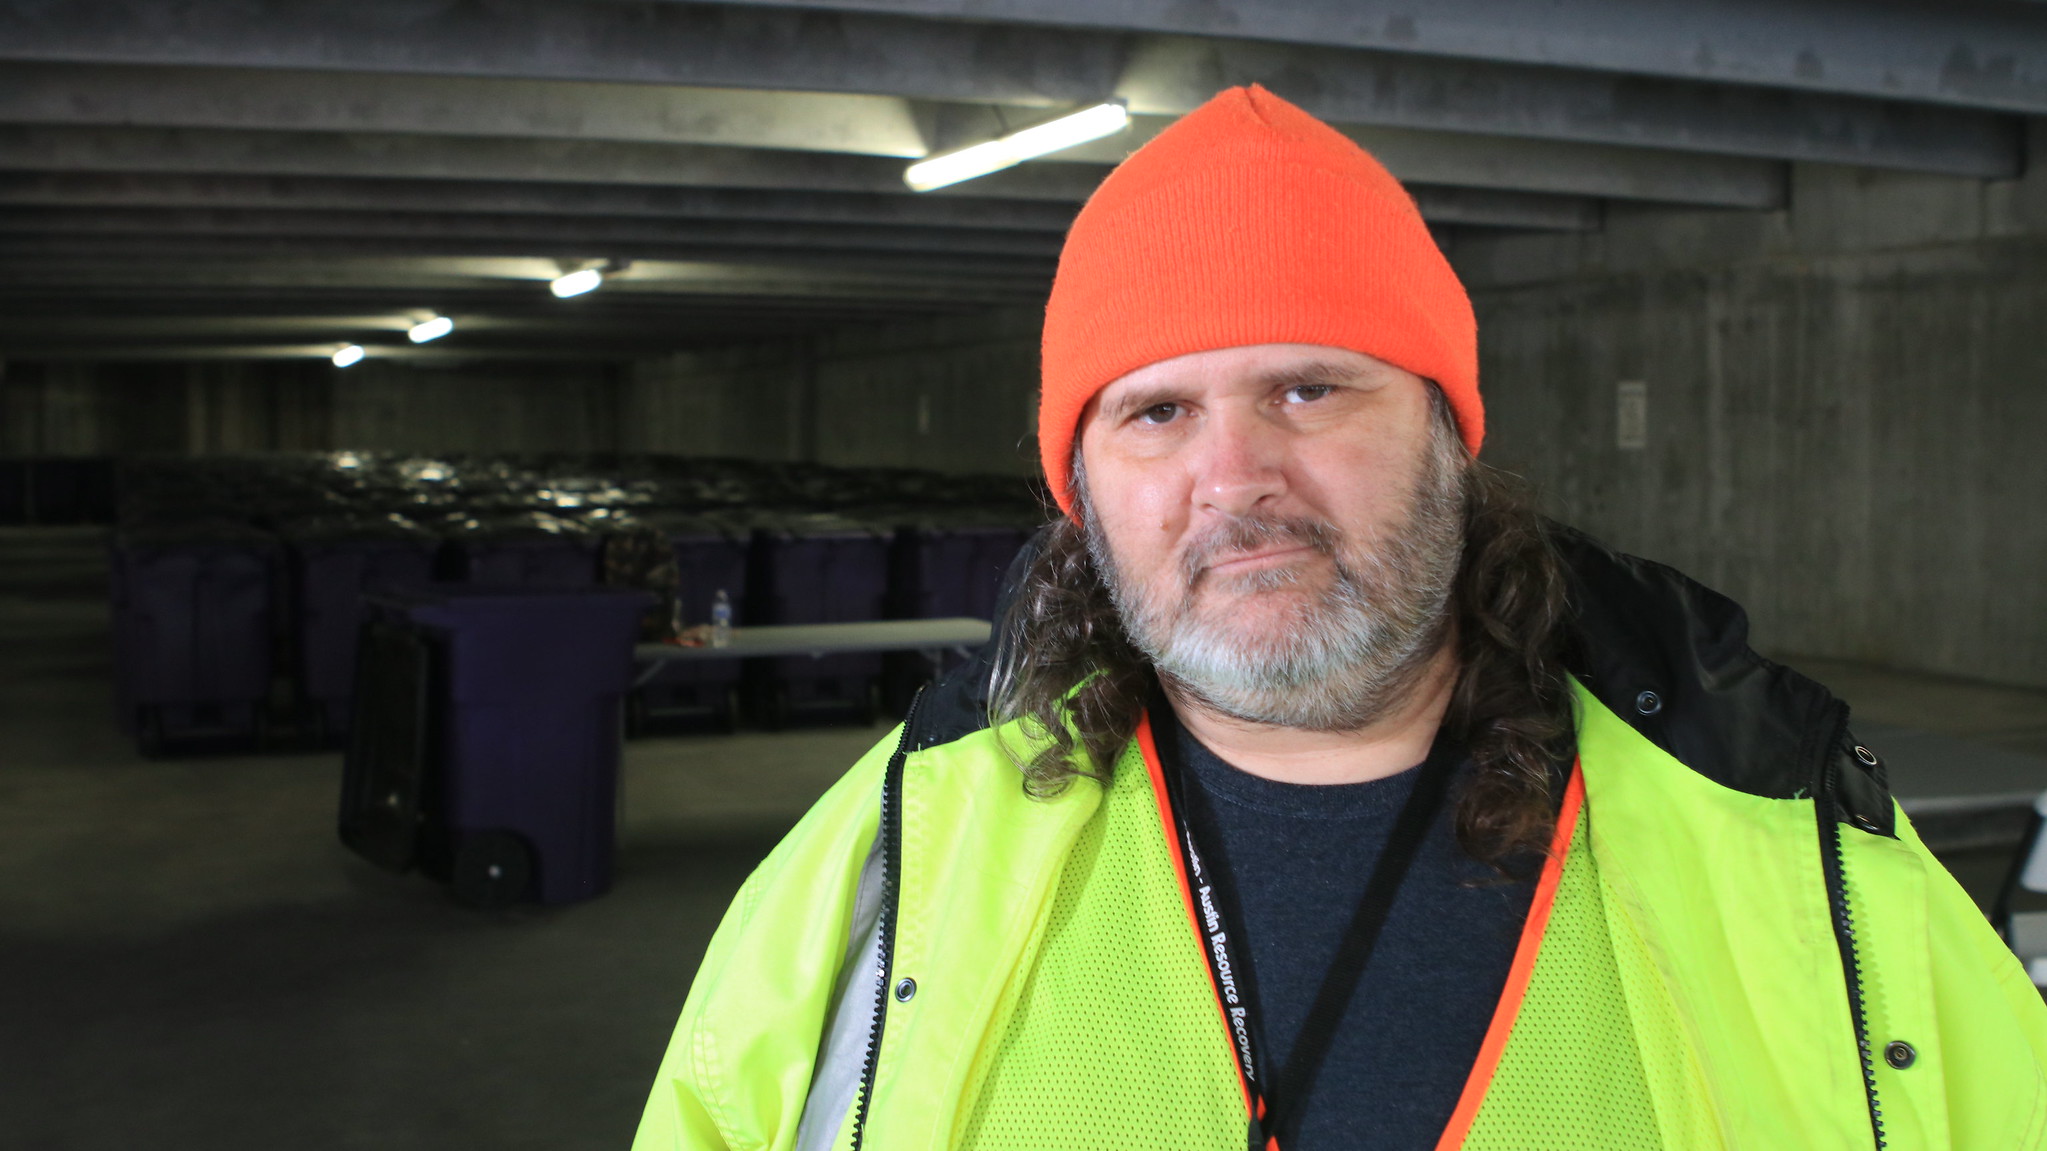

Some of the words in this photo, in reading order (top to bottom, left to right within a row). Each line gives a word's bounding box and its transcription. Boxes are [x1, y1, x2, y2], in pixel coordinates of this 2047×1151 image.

[1199, 885, 1220, 933] Austin
[1210, 931, 1240, 1004] Resource
[1229, 1006, 1256, 1082] Recovery
